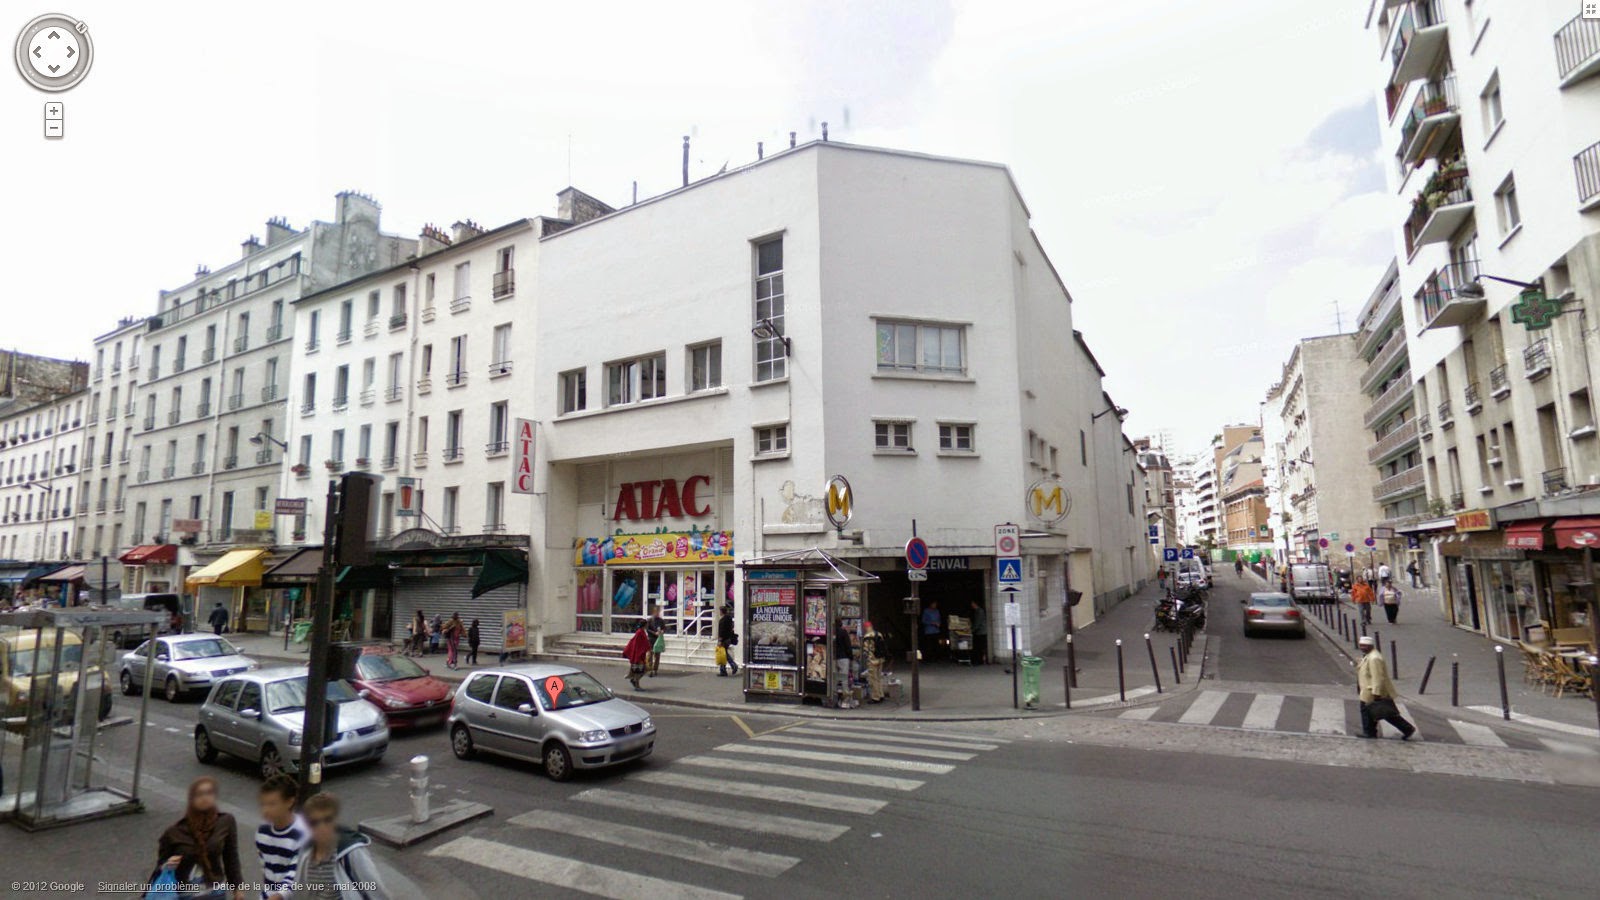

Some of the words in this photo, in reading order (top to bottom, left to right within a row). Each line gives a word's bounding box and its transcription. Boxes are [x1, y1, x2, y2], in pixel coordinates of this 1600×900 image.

[518, 421, 532, 491] ATAC
[613, 475, 711, 521] ATAC
[829, 483, 849, 516] M
[1032, 486, 1062, 516] M
[907, 557, 967, 570] ENVAL
[756, 606, 763, 614] LA
[764, 606, 789, 614] NOUVELLE
[773, 613, 793, 622] UNIQUE
